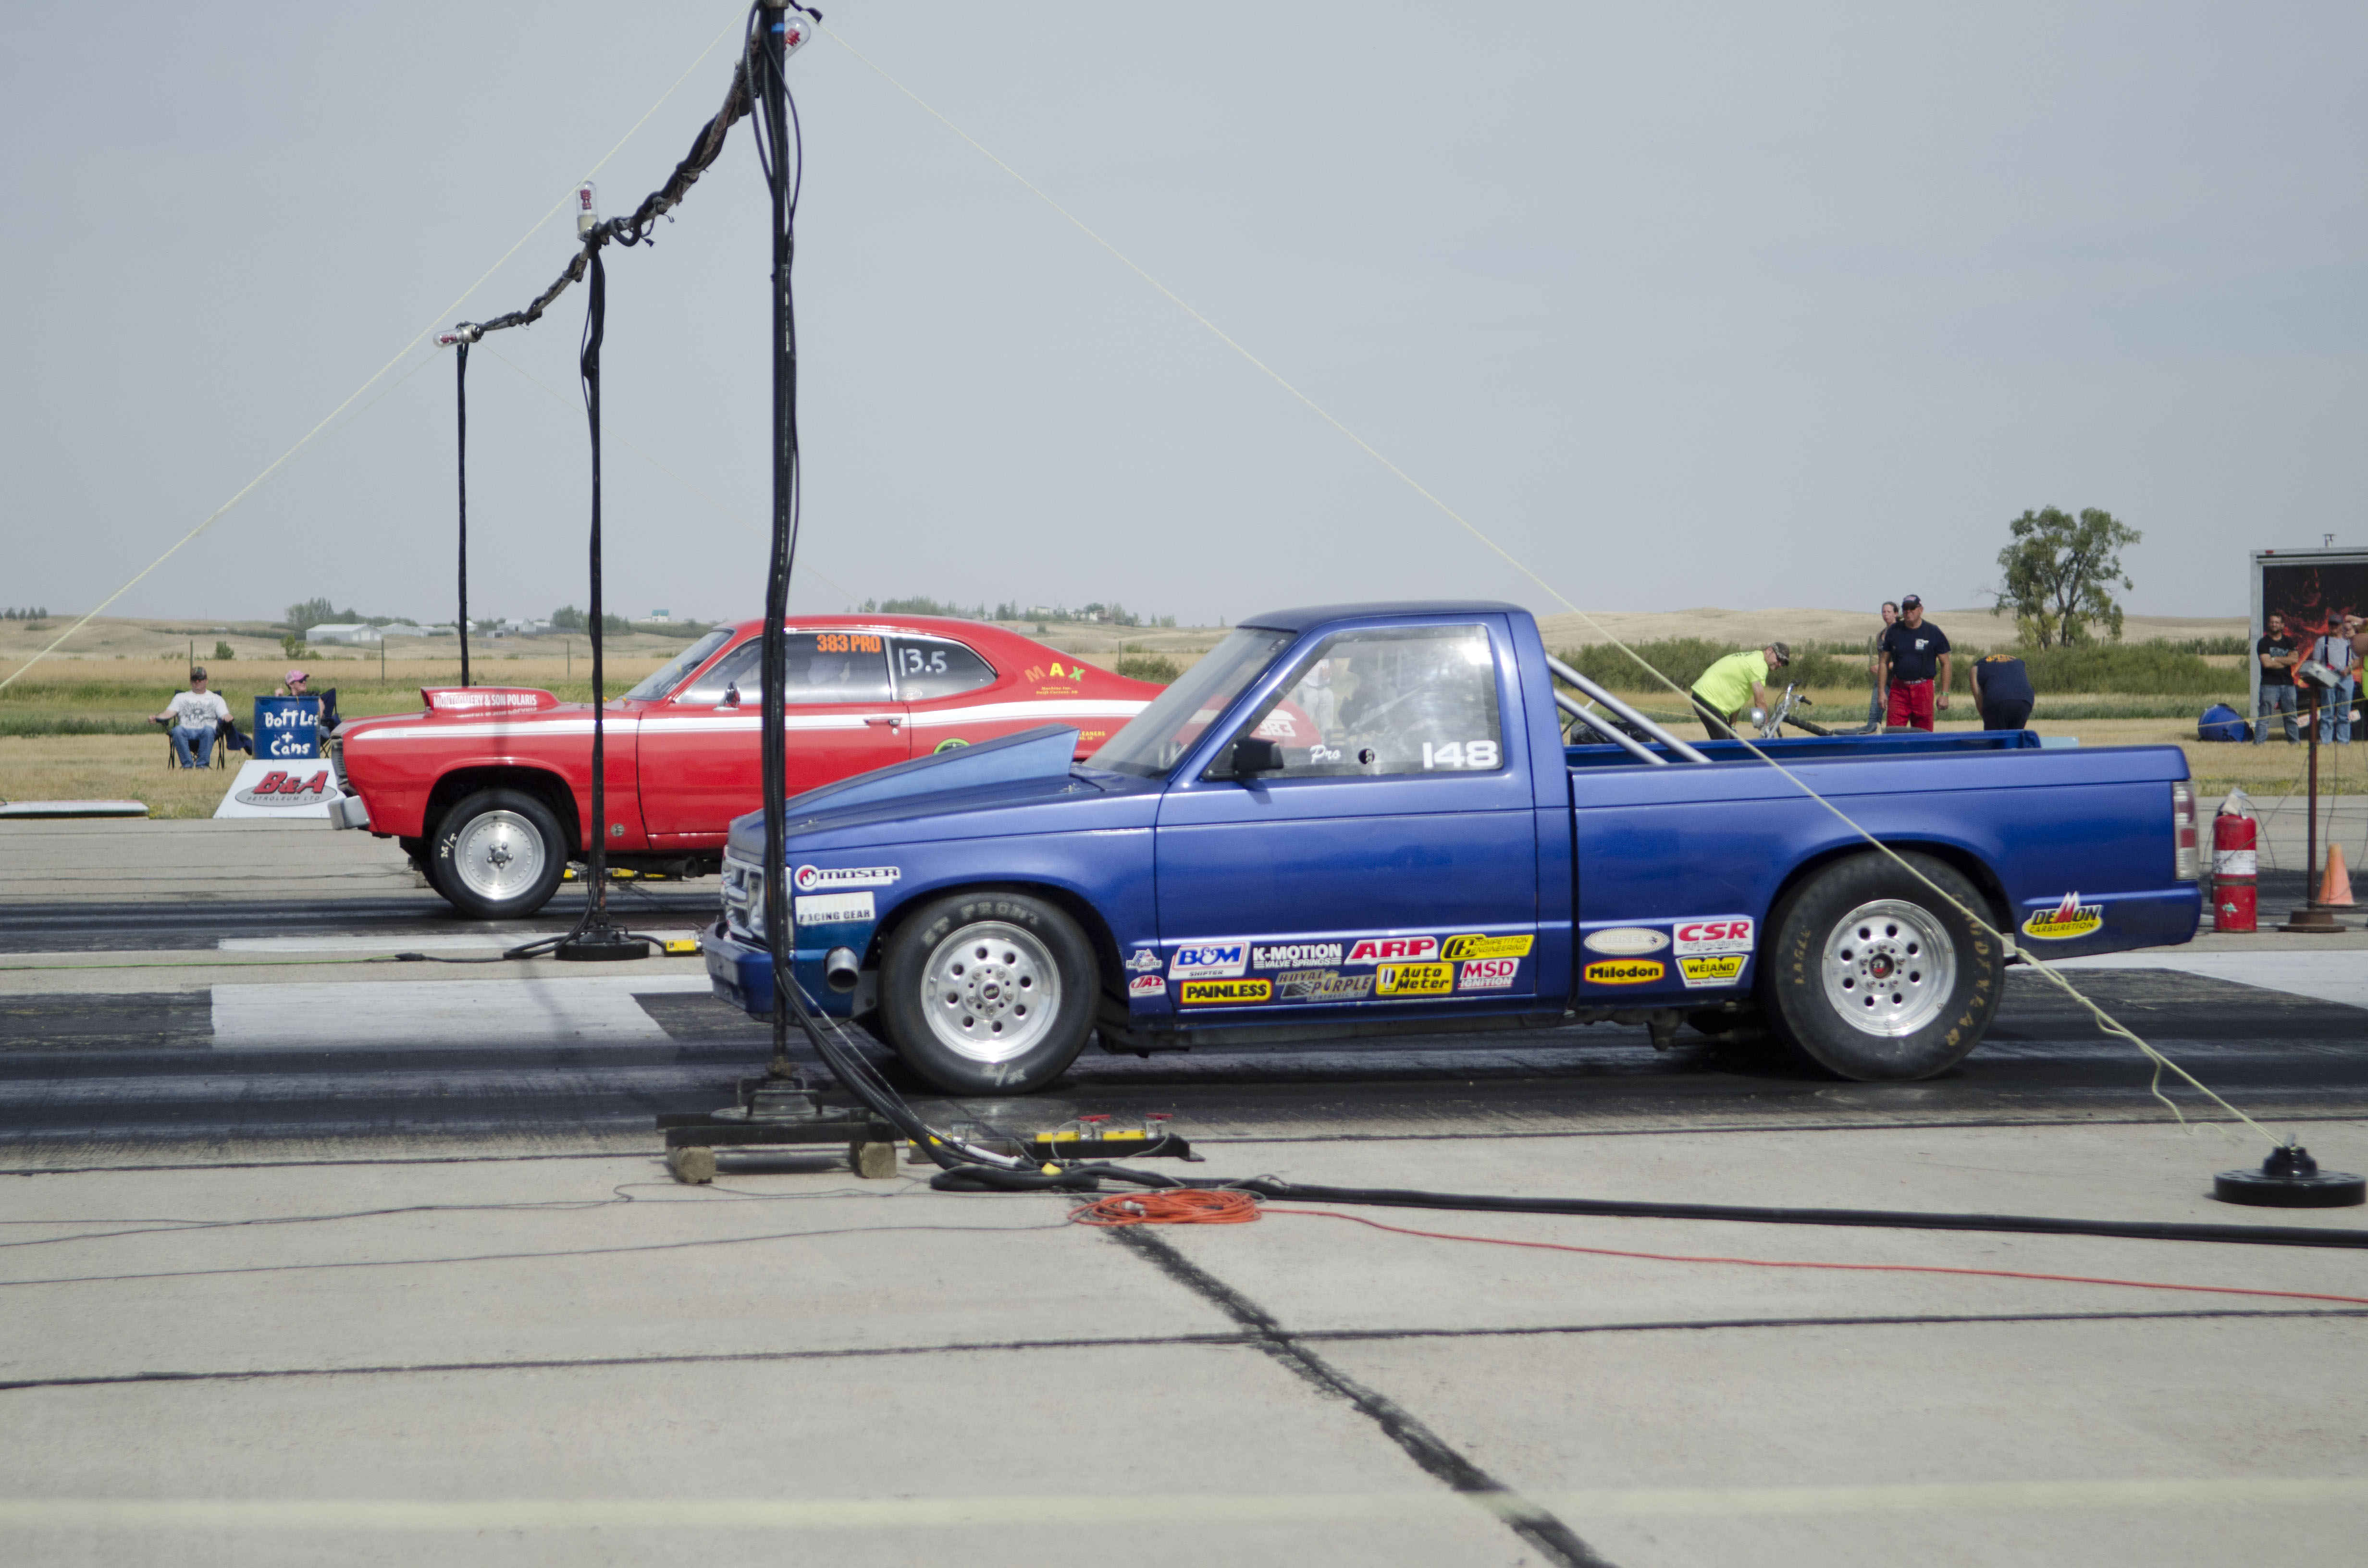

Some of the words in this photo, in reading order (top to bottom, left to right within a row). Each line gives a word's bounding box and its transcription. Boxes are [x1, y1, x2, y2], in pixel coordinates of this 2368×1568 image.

[816, 634, 848, 652] 383
[850, 635, 881, 652] PRO
[899, 648, 947, 677] 13.5
[1024, 662, 1085, 683] MAX
[433, 695, 483, 708] MONTGOMERY
[484, 695, 490, 706] &
[492, 695, 505, 706] SON
[507, 694, 537, 706] POLARIS
[271, 740, 311, 756] Cans
[1309, 745, 1341, 764] Pro
[1422, 740, 1497, 768] 148
[253, 770, 329, 794] B&A
[843, 910, 870, 919] GEAR
[2032, 893, 2102, 925] DEMON
[1678, 921, 1750, 941] CSR
[2029, 921, 2096, 933] CARBURETION
[1351, 939, 1435, 959] ARP
[1471, 944, 1526, 953] ENGINEERING
[1474, 937, 1528, 946] COMPETITION
[1177, 947, 1243, 966] B&M
[1253, 943, 1343, 961] K-MOTION
[1265, 960, 1291, 968] VALVE
[1292, 957, 1331, 967] SPRINGS
[1462, 961, 1514, 978] MSD
[1688, 963, 1735, 973] WEIAND
[1278, 971, 1322, 982] ROYAL
[1400, 967, 1442, 978] Auto
[1590, 966, 1659, 978] Milodon
[1394, 979, 1449, 992] Meter
[1460, 977, 1511, 988] IGNITION
[1186, 983, 1268, 999] PAINLESS
